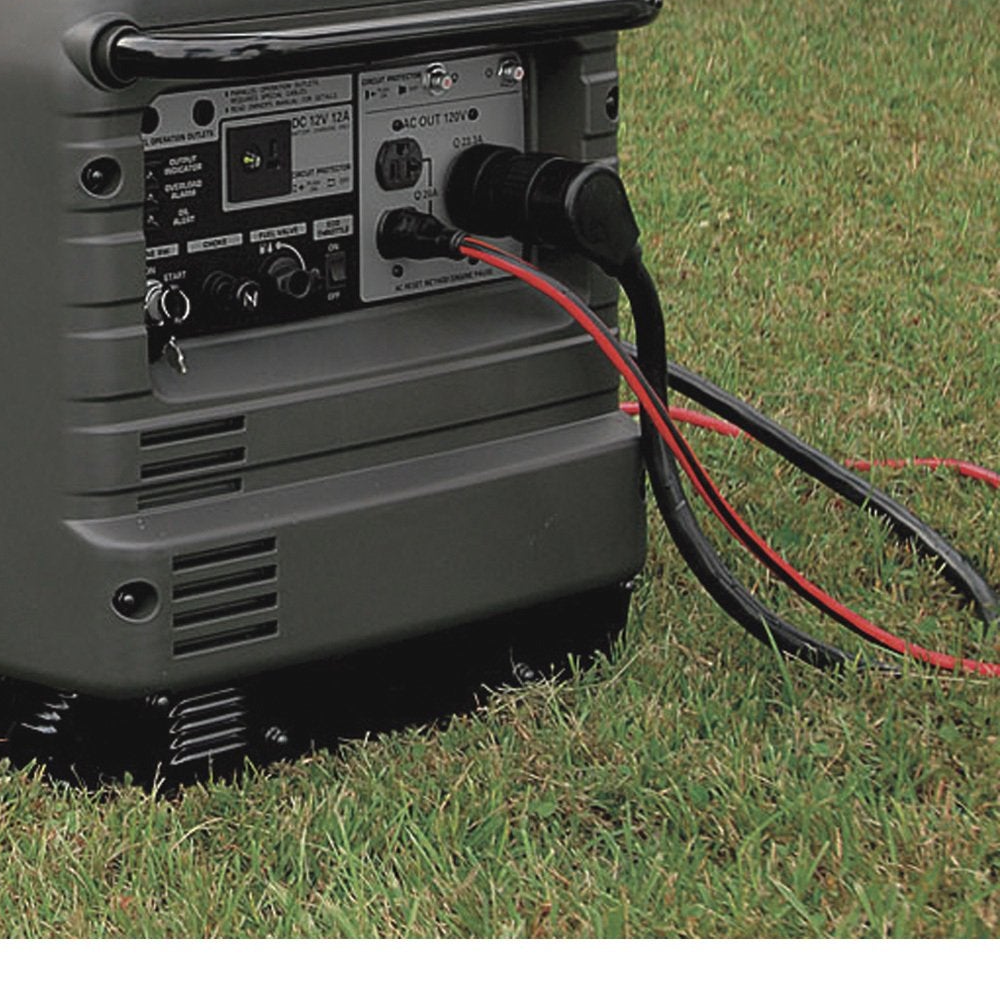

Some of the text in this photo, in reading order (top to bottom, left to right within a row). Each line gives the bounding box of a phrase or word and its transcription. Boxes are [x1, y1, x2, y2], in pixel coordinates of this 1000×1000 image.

[292, 110, 350, 129] DC 12V 12A
[403, 110, 467, 128] AC OUT 120V
